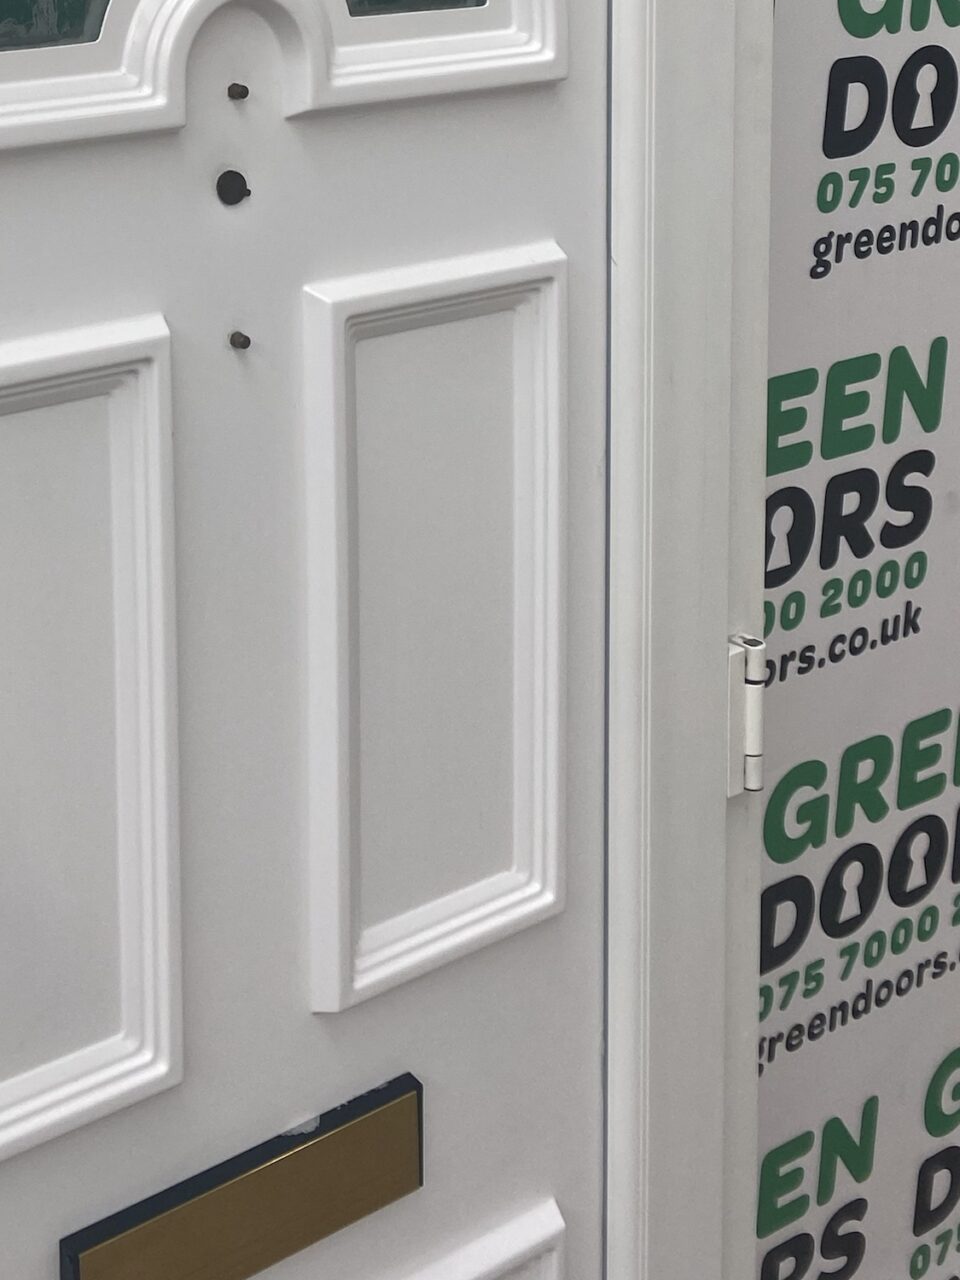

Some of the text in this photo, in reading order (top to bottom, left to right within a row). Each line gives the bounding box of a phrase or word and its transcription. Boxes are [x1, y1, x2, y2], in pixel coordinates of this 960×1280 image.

[823, 45, 958, 159] DO
[817, 152, 959, 214] 075 70
[820, 551, 928, 619] 2000
[763, 707, 960, 865] GRE
[760, 814, 960, 976] DOO
[839, 905, 940, 981] 7000
[756, 1094, 879, 1239] EN
[909, 1223, 960, 1280] 07
